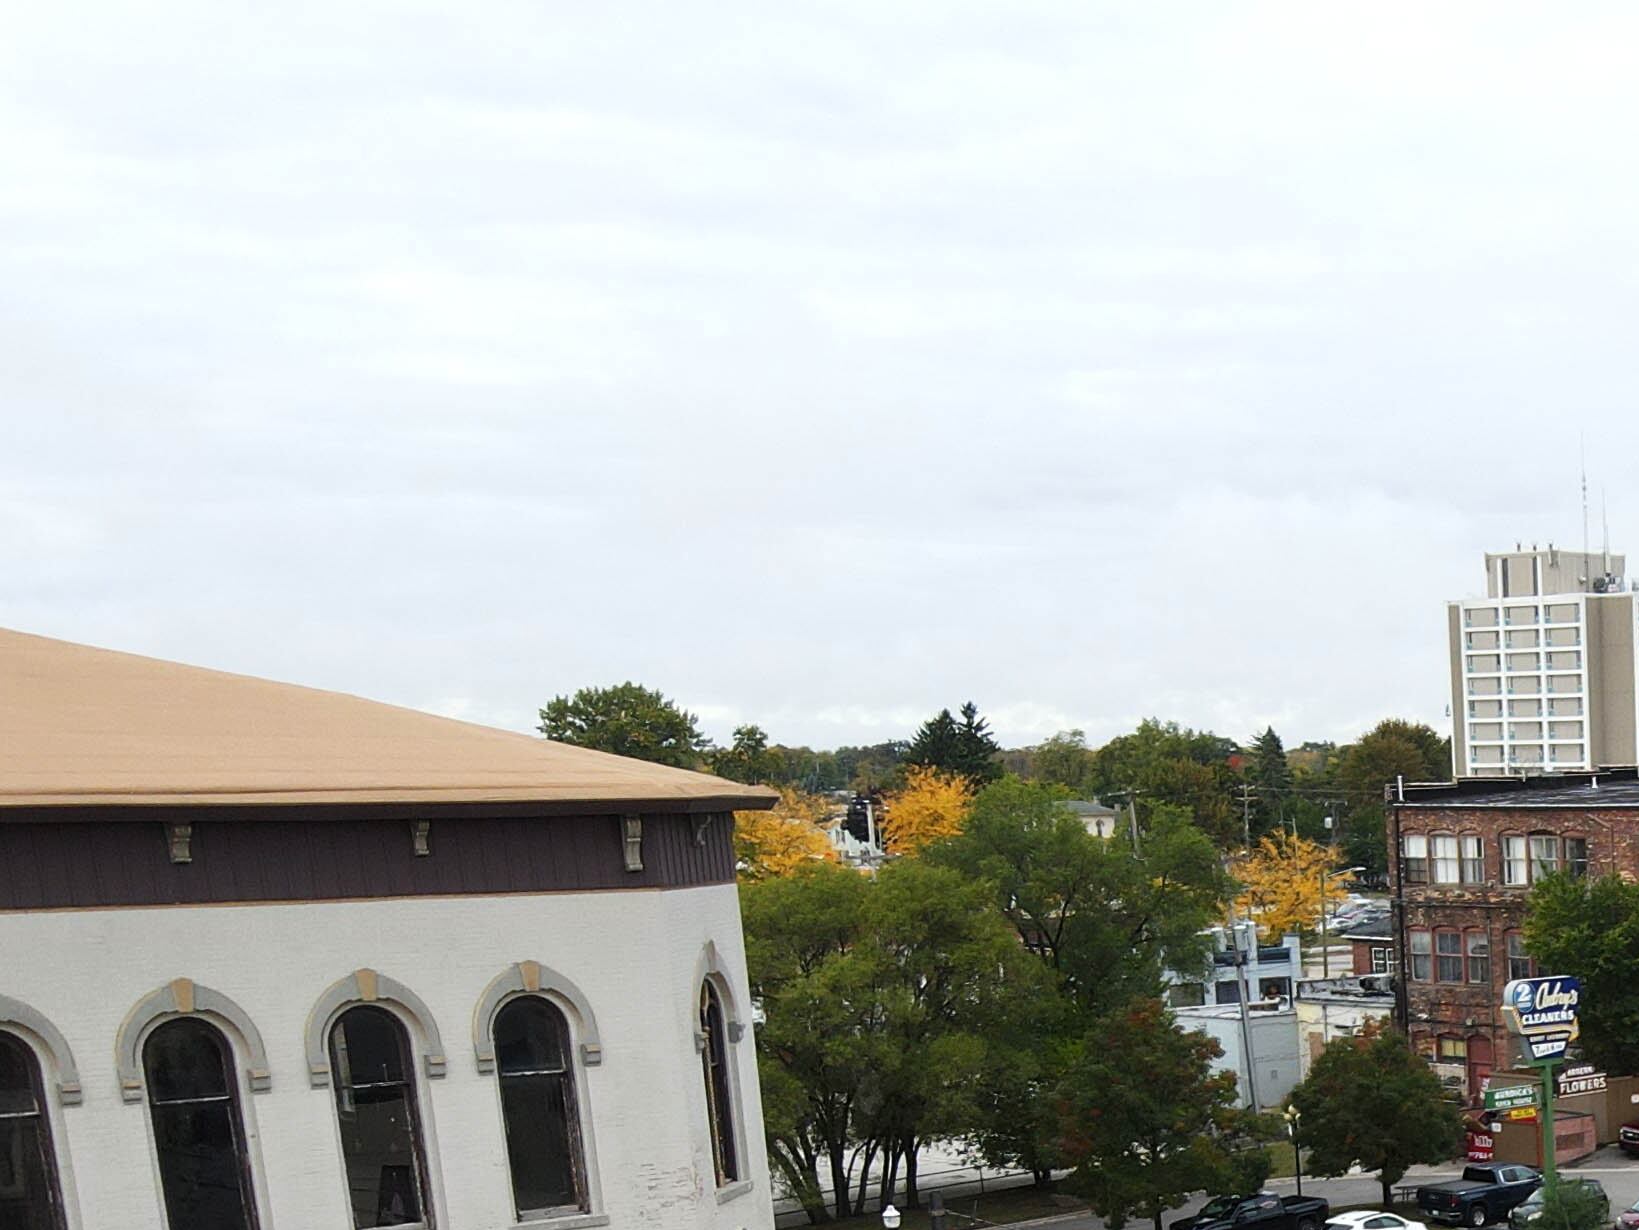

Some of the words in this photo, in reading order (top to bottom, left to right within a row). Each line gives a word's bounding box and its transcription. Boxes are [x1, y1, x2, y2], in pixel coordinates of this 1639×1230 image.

[1517, 983, 1532, 1002] 2
[1522, 1010, 1574, 1025] CLEANERS
[1560, 1077, 1607, 1094] FLOWERS
